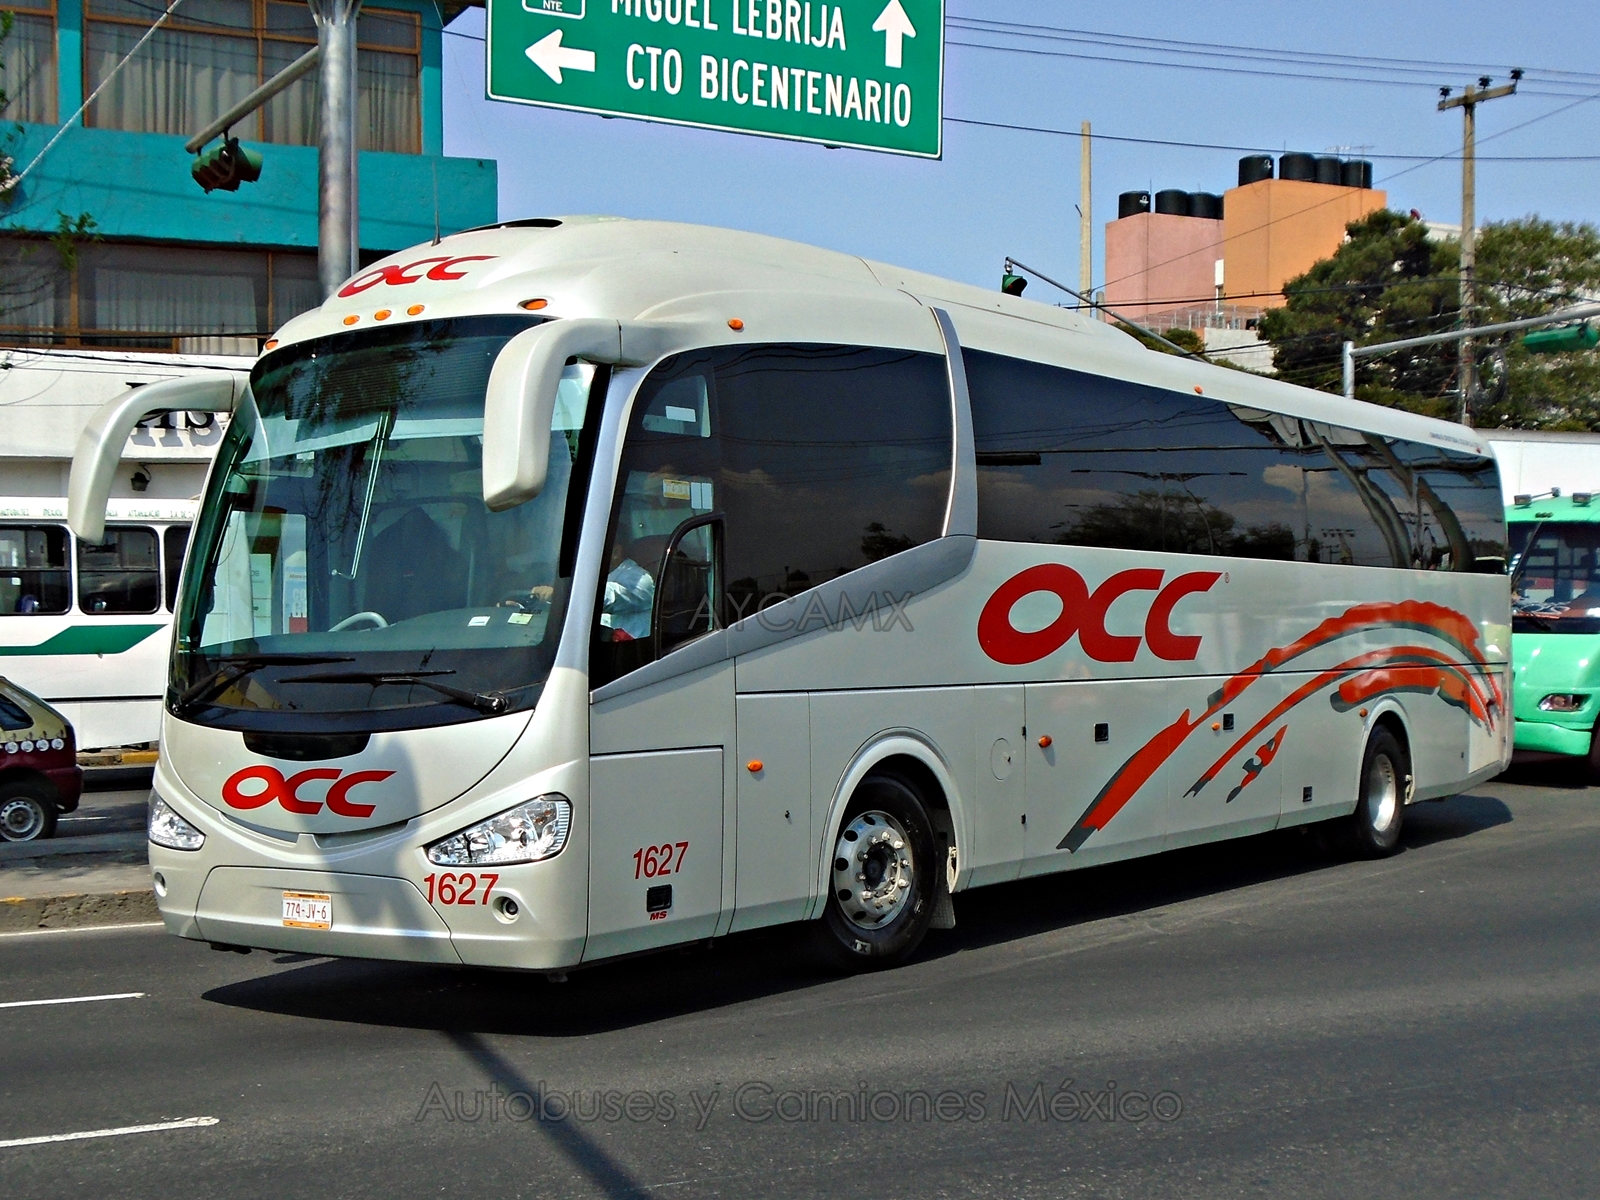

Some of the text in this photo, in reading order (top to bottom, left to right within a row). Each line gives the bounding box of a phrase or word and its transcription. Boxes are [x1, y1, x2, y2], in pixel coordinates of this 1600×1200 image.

[543, 1, 563, 12] NTE
[732, 0, 847, 51] LEBRIJA
[627, 43, 913, 128] CTO BICENTENARIO
[337, 255, 500, 298] OCC
[977, 562, 1223, 666] OCC
[222, 765, 397, 818] OCC
[632, 841, 689, 880] 1627
[424, 872, 499, 906] 1627
[650, 911, 668, 921] MS
